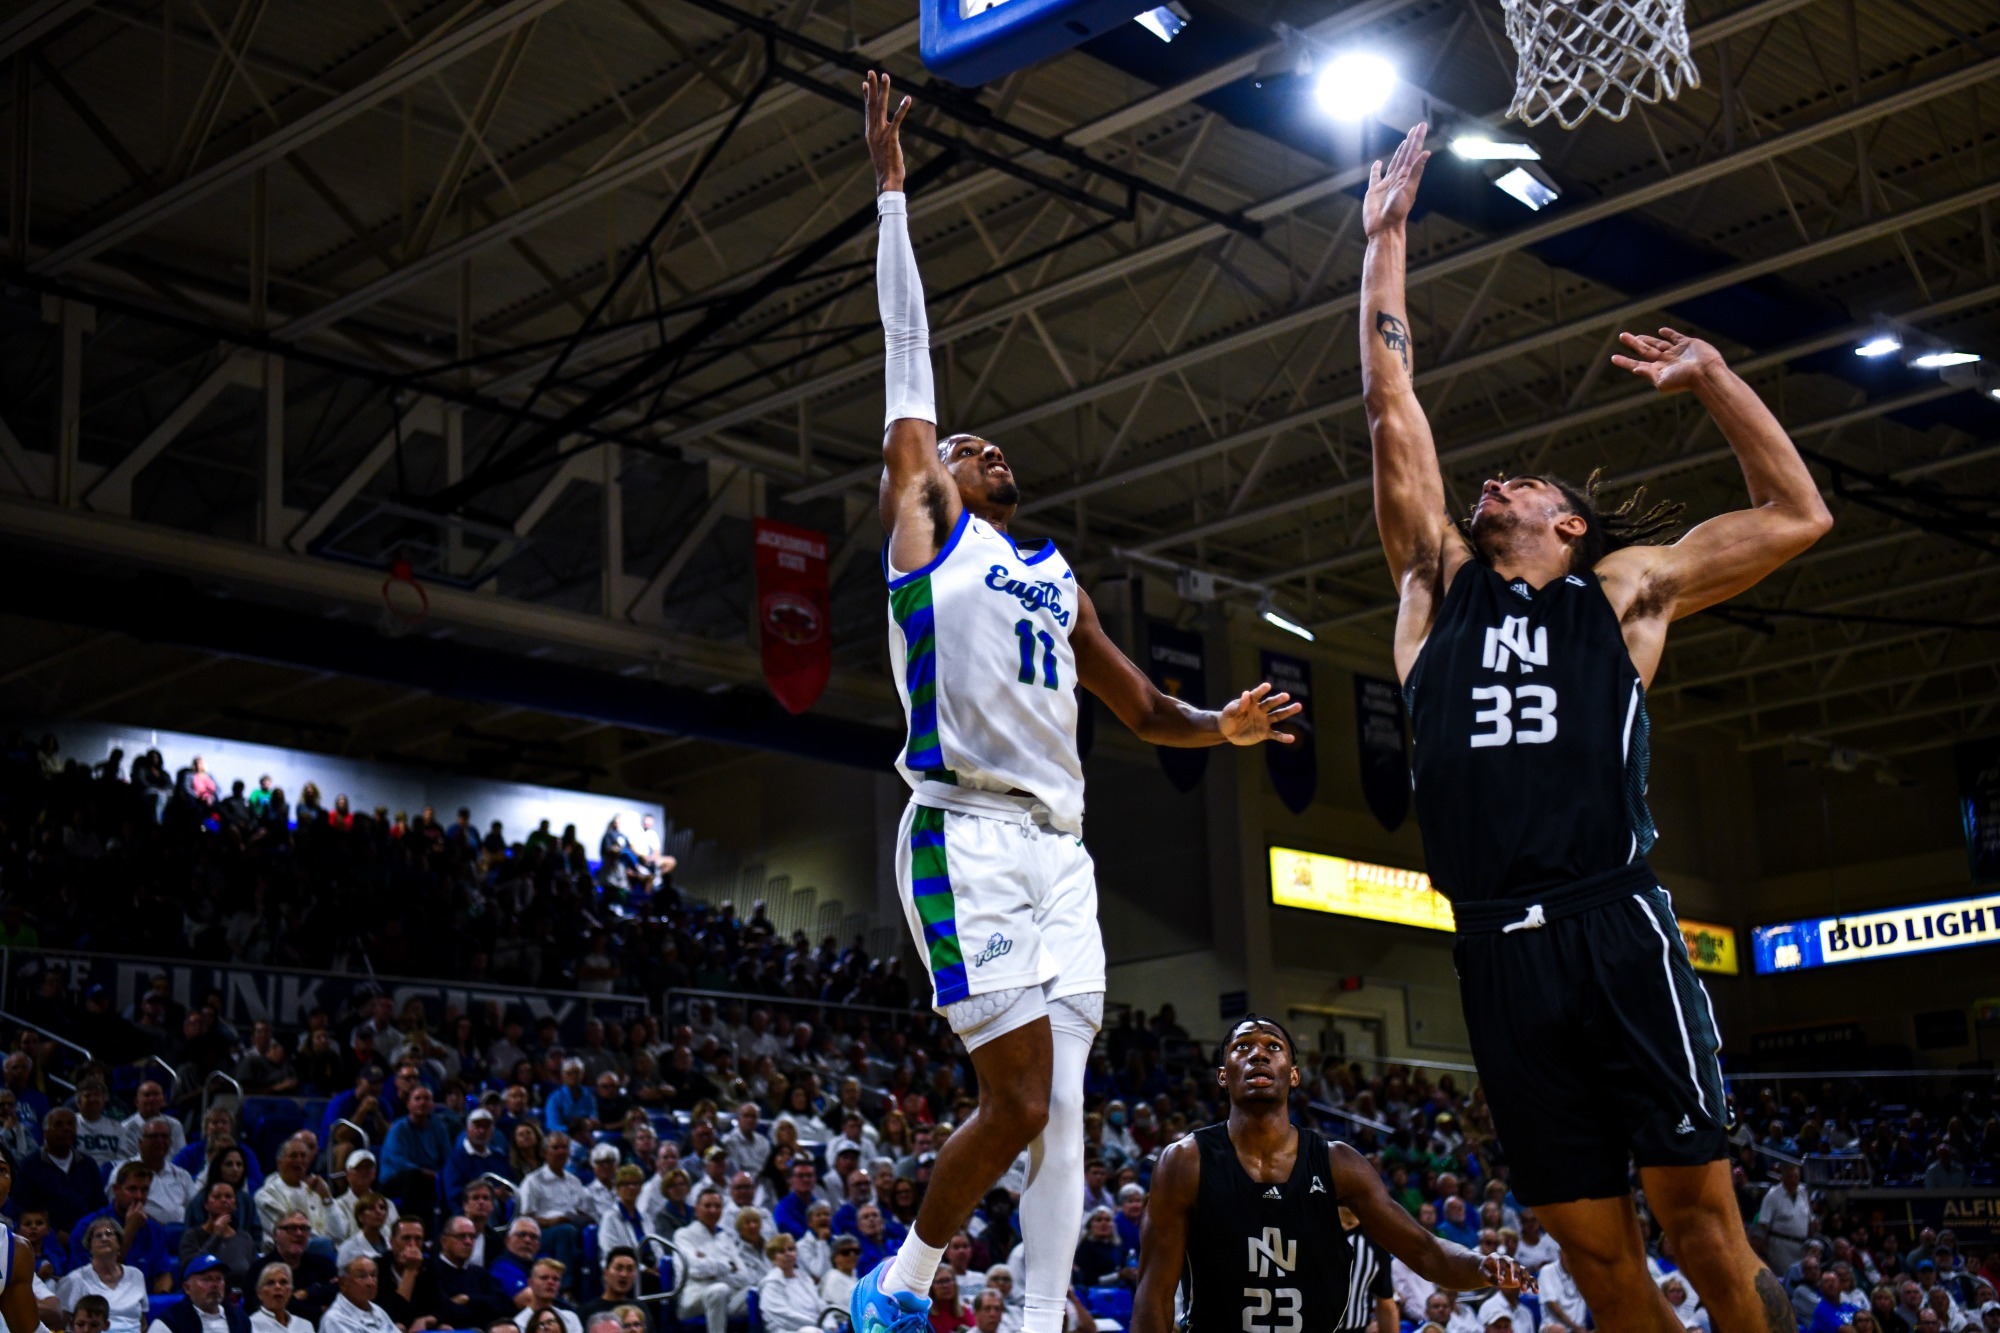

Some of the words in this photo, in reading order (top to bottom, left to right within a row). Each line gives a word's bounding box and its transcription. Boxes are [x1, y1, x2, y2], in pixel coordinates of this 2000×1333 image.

[985, 564, 1070, 627] Eagles
[1014, 618, 1059, 691] 11
[1470, 684, 1558, 748] 33
[974, 939, 1013, 968] FGCU
[1828, 922, 1899, 952] BUD
[1241, 1287, 1304, 1333] 23
